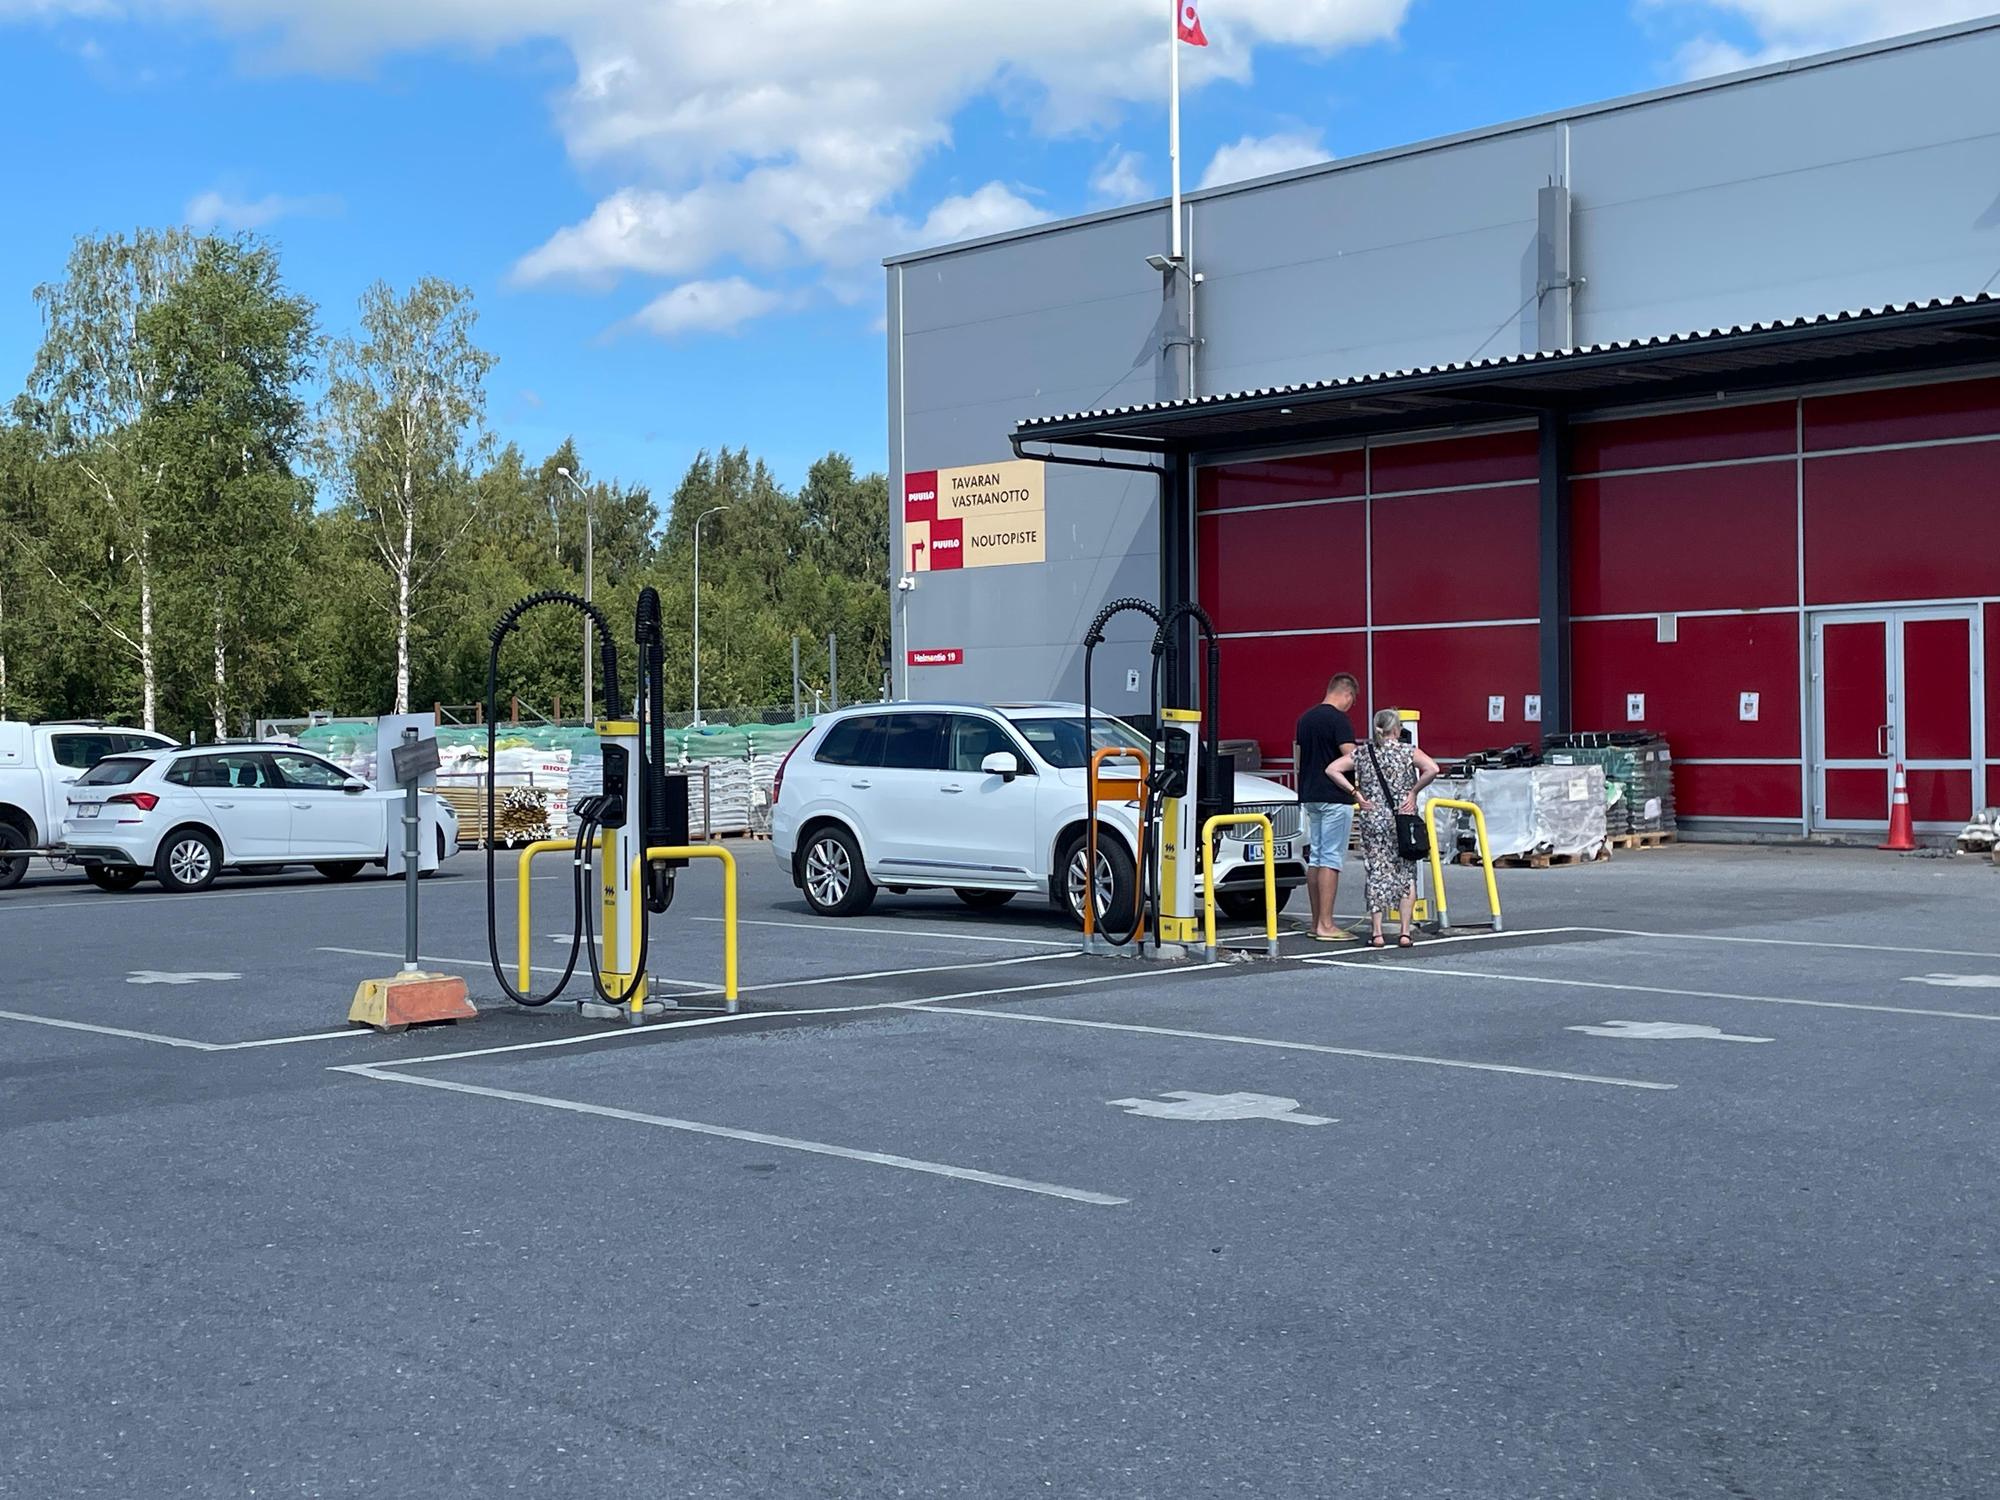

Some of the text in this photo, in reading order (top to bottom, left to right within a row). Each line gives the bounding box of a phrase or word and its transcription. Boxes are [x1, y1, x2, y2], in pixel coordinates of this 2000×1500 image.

[952, 473, 1000, 490] TAVARAN
[908, 491, 935, 502] PUUILO
[952, 489, 1030, 508] VASTAANOTTO
[933, 539, 960, 550] PUUILO
[971, 531, 1037, 548] NOUTOPISTE
